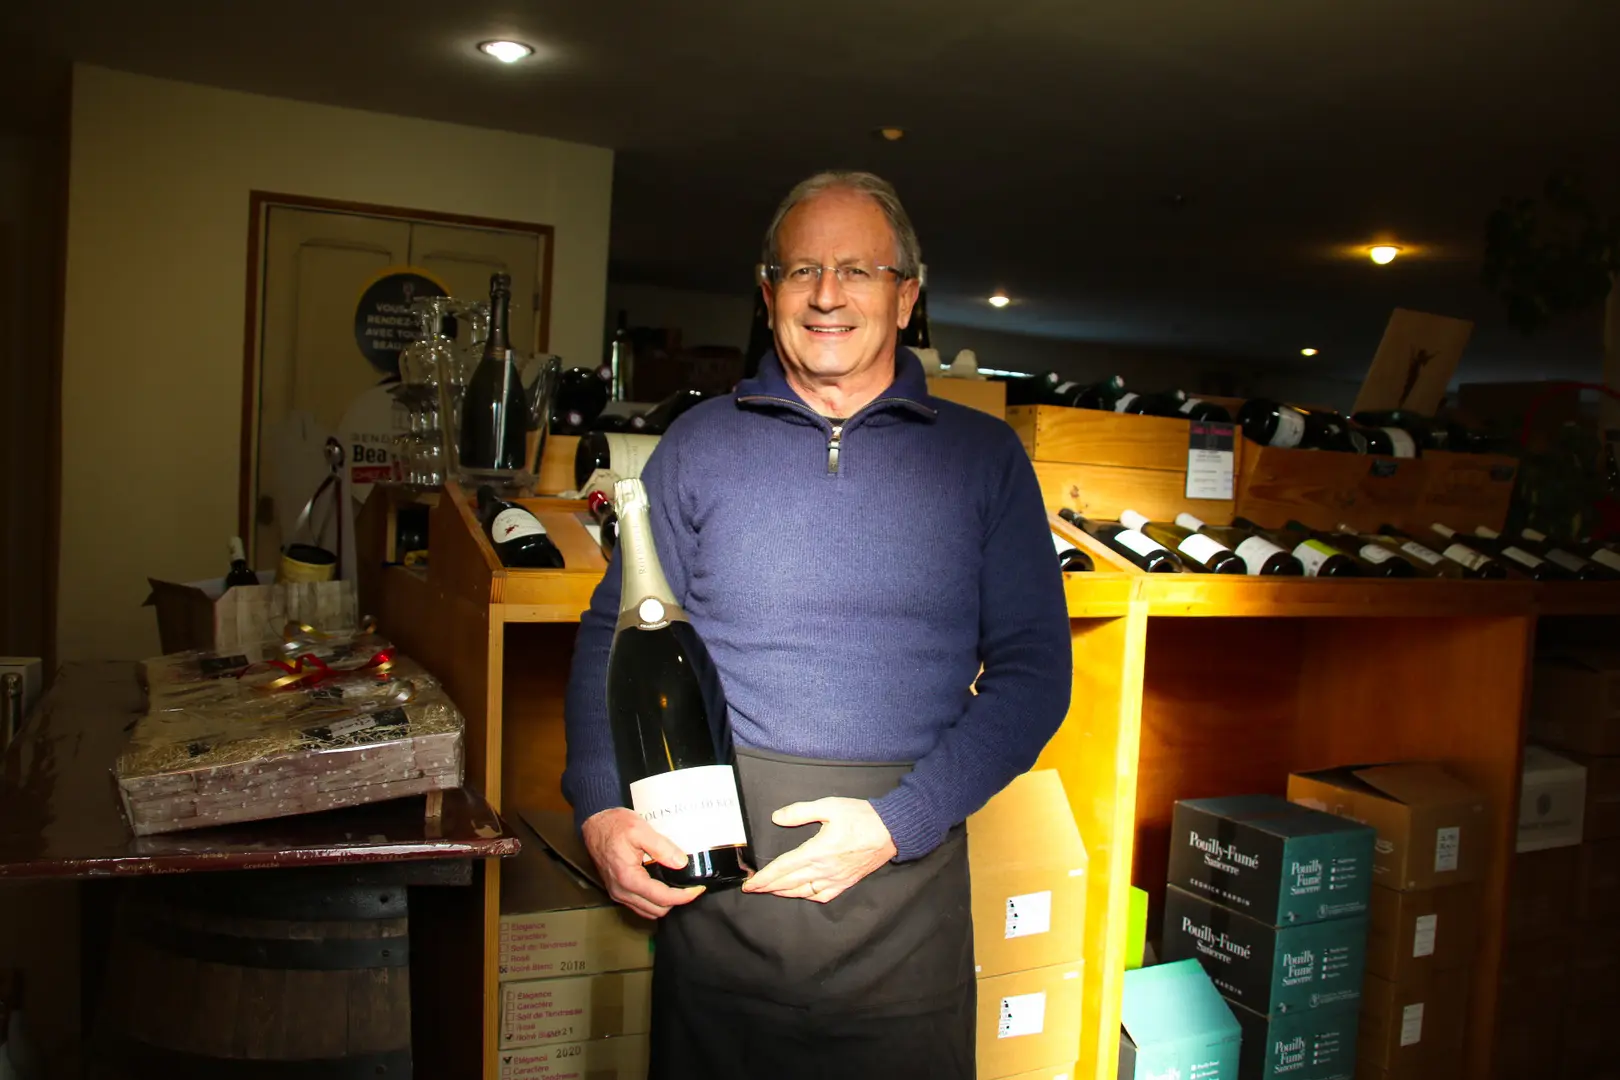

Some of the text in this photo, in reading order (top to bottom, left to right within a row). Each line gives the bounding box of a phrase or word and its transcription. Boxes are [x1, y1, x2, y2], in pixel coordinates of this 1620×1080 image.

[352, 444, 387, 463] Bea
[640, 807, 672, 822] OUIS
[1189, 830, 1259, 869] Pouilly-Fumé
[1204, 853, 1240, 876] Sancerre
[1291, 859, 1322, 876] Pouilly
[1182, 916, 1251, 960] Pouilly-Fumé
[1196, 939, 1232, 964] Sancerre
[560, 961, 587, 971] 2018
[556, 1045, 582, 1058] 2020
[1274, 1036, 1305, 1055] Pouilly
